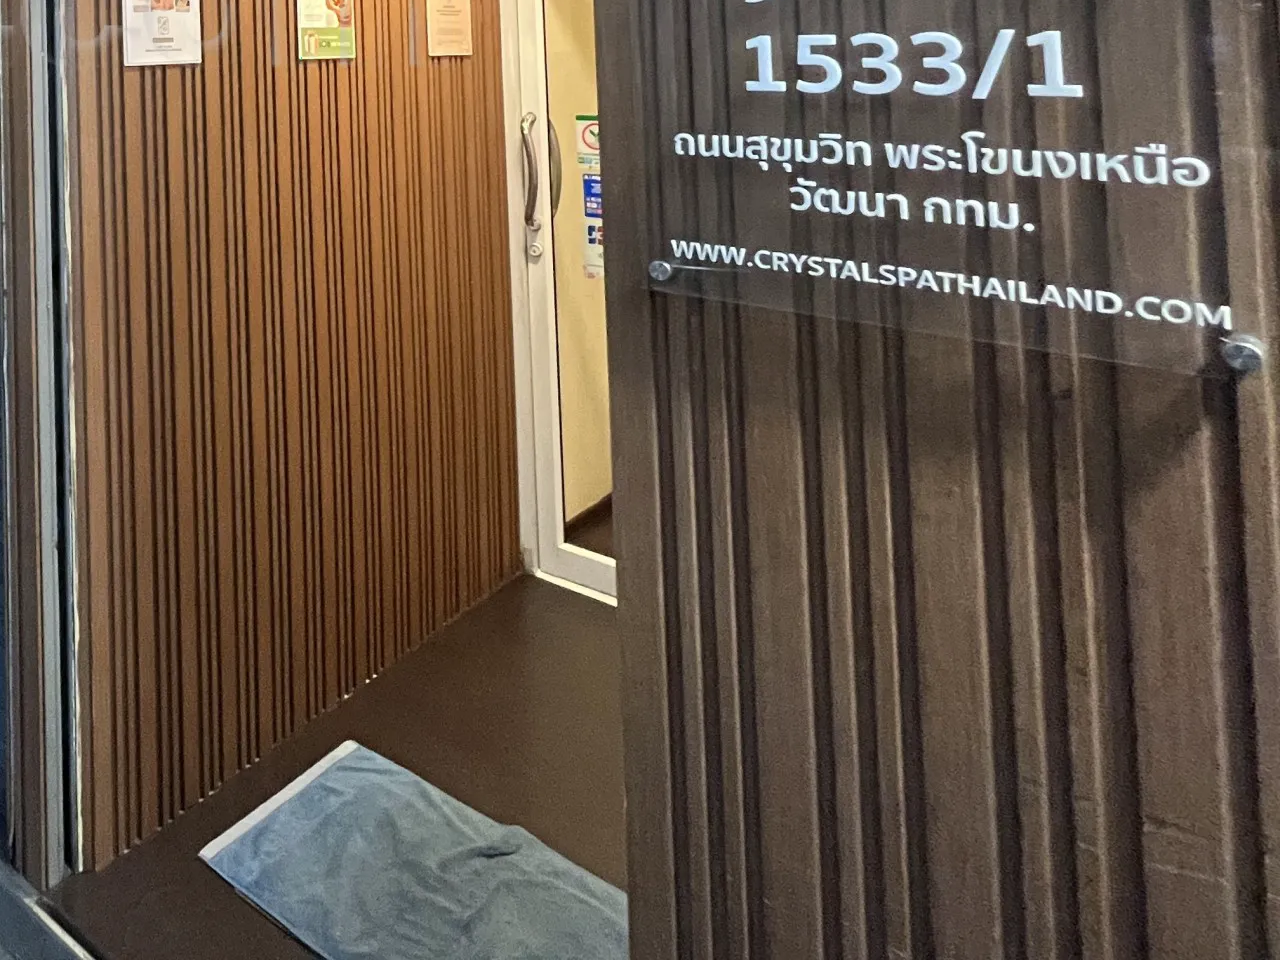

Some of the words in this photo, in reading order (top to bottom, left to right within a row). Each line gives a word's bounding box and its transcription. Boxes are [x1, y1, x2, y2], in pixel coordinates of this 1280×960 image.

[744, 28, 1084, 100] 1533/1
[673, 132, 872, 172] ถนนสุขุมวิท
[883, 130, 1211, 188] พระโขนงเหนือ
[789, 177, 910, 221] วัฒนา
[923, 196, 1035, 232] กทม.
[670, 239, 1234, 331] WWW.CRYSTALSPATHAILAND.COM
